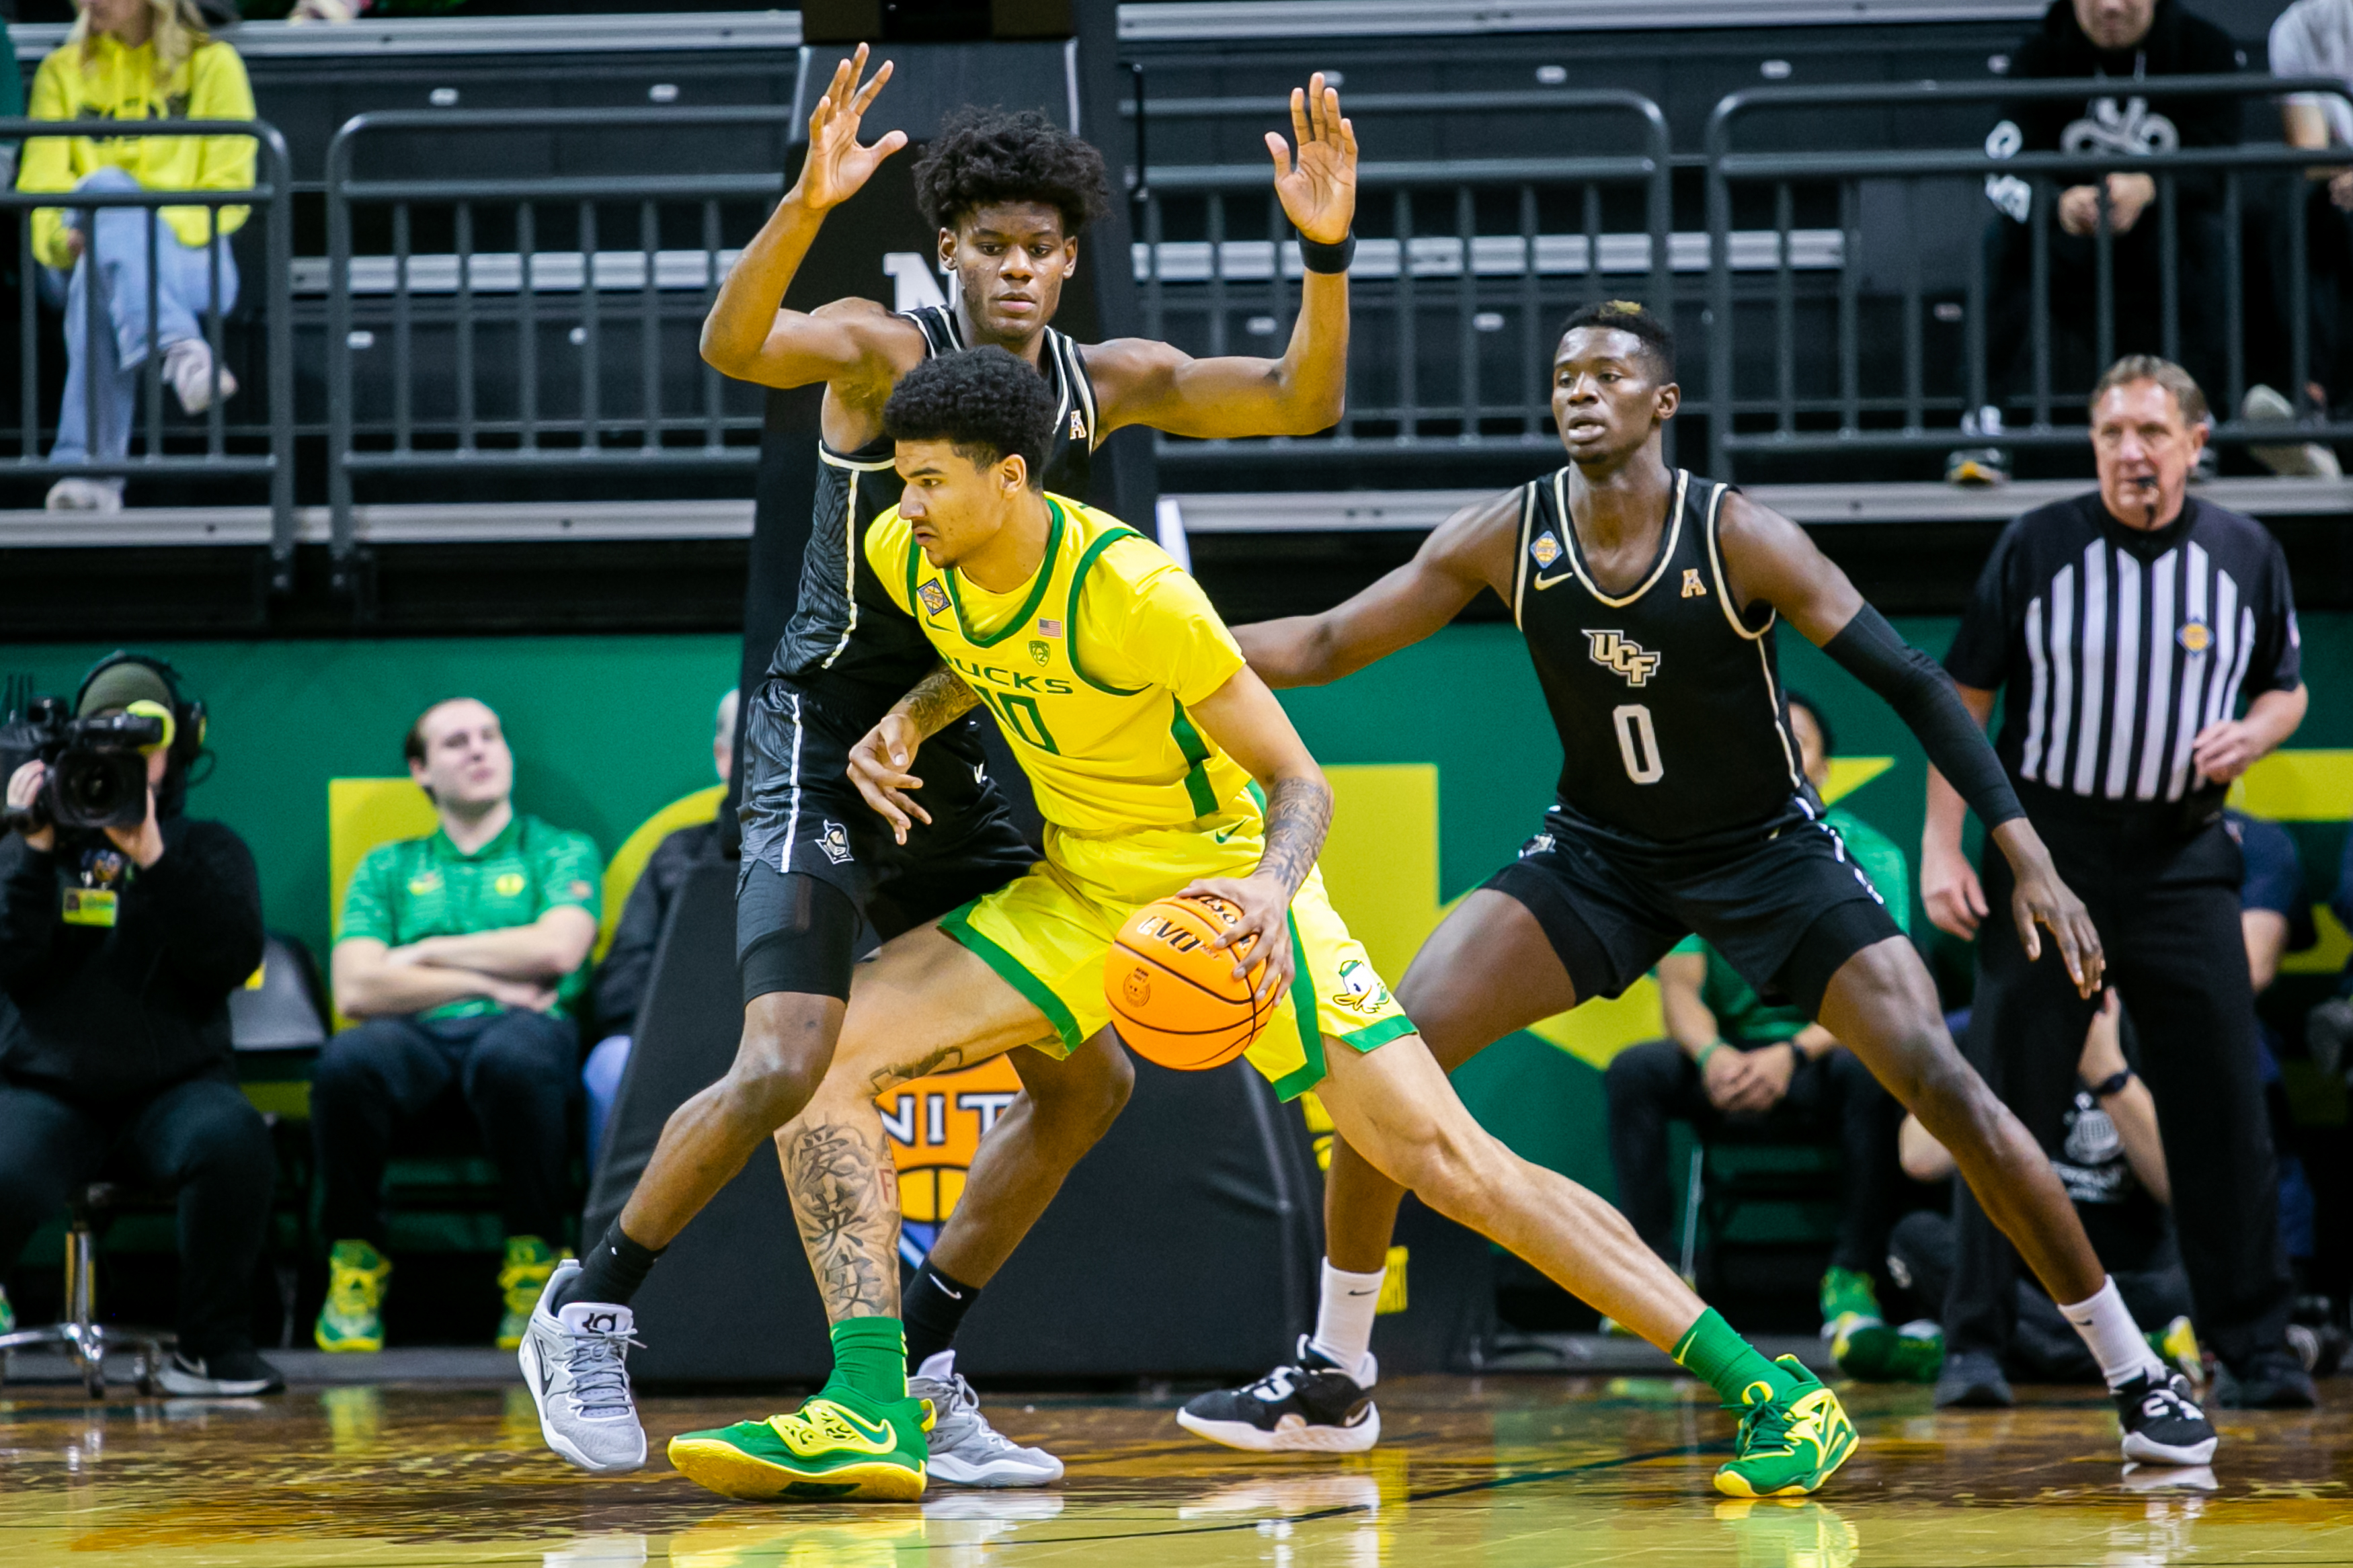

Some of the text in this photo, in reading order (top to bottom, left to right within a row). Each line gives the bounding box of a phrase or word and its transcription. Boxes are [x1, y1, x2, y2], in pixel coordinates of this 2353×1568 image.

[1681, 568, 1707, 598] A
[943, 649, 1074, 694] UCKS
[1588, 630, 1659, 686] UCF
[972, 684, 1061, 755] 10
[1613, 704, 1664, 784] 0
[1137, 915, 1201, 953] EVO
